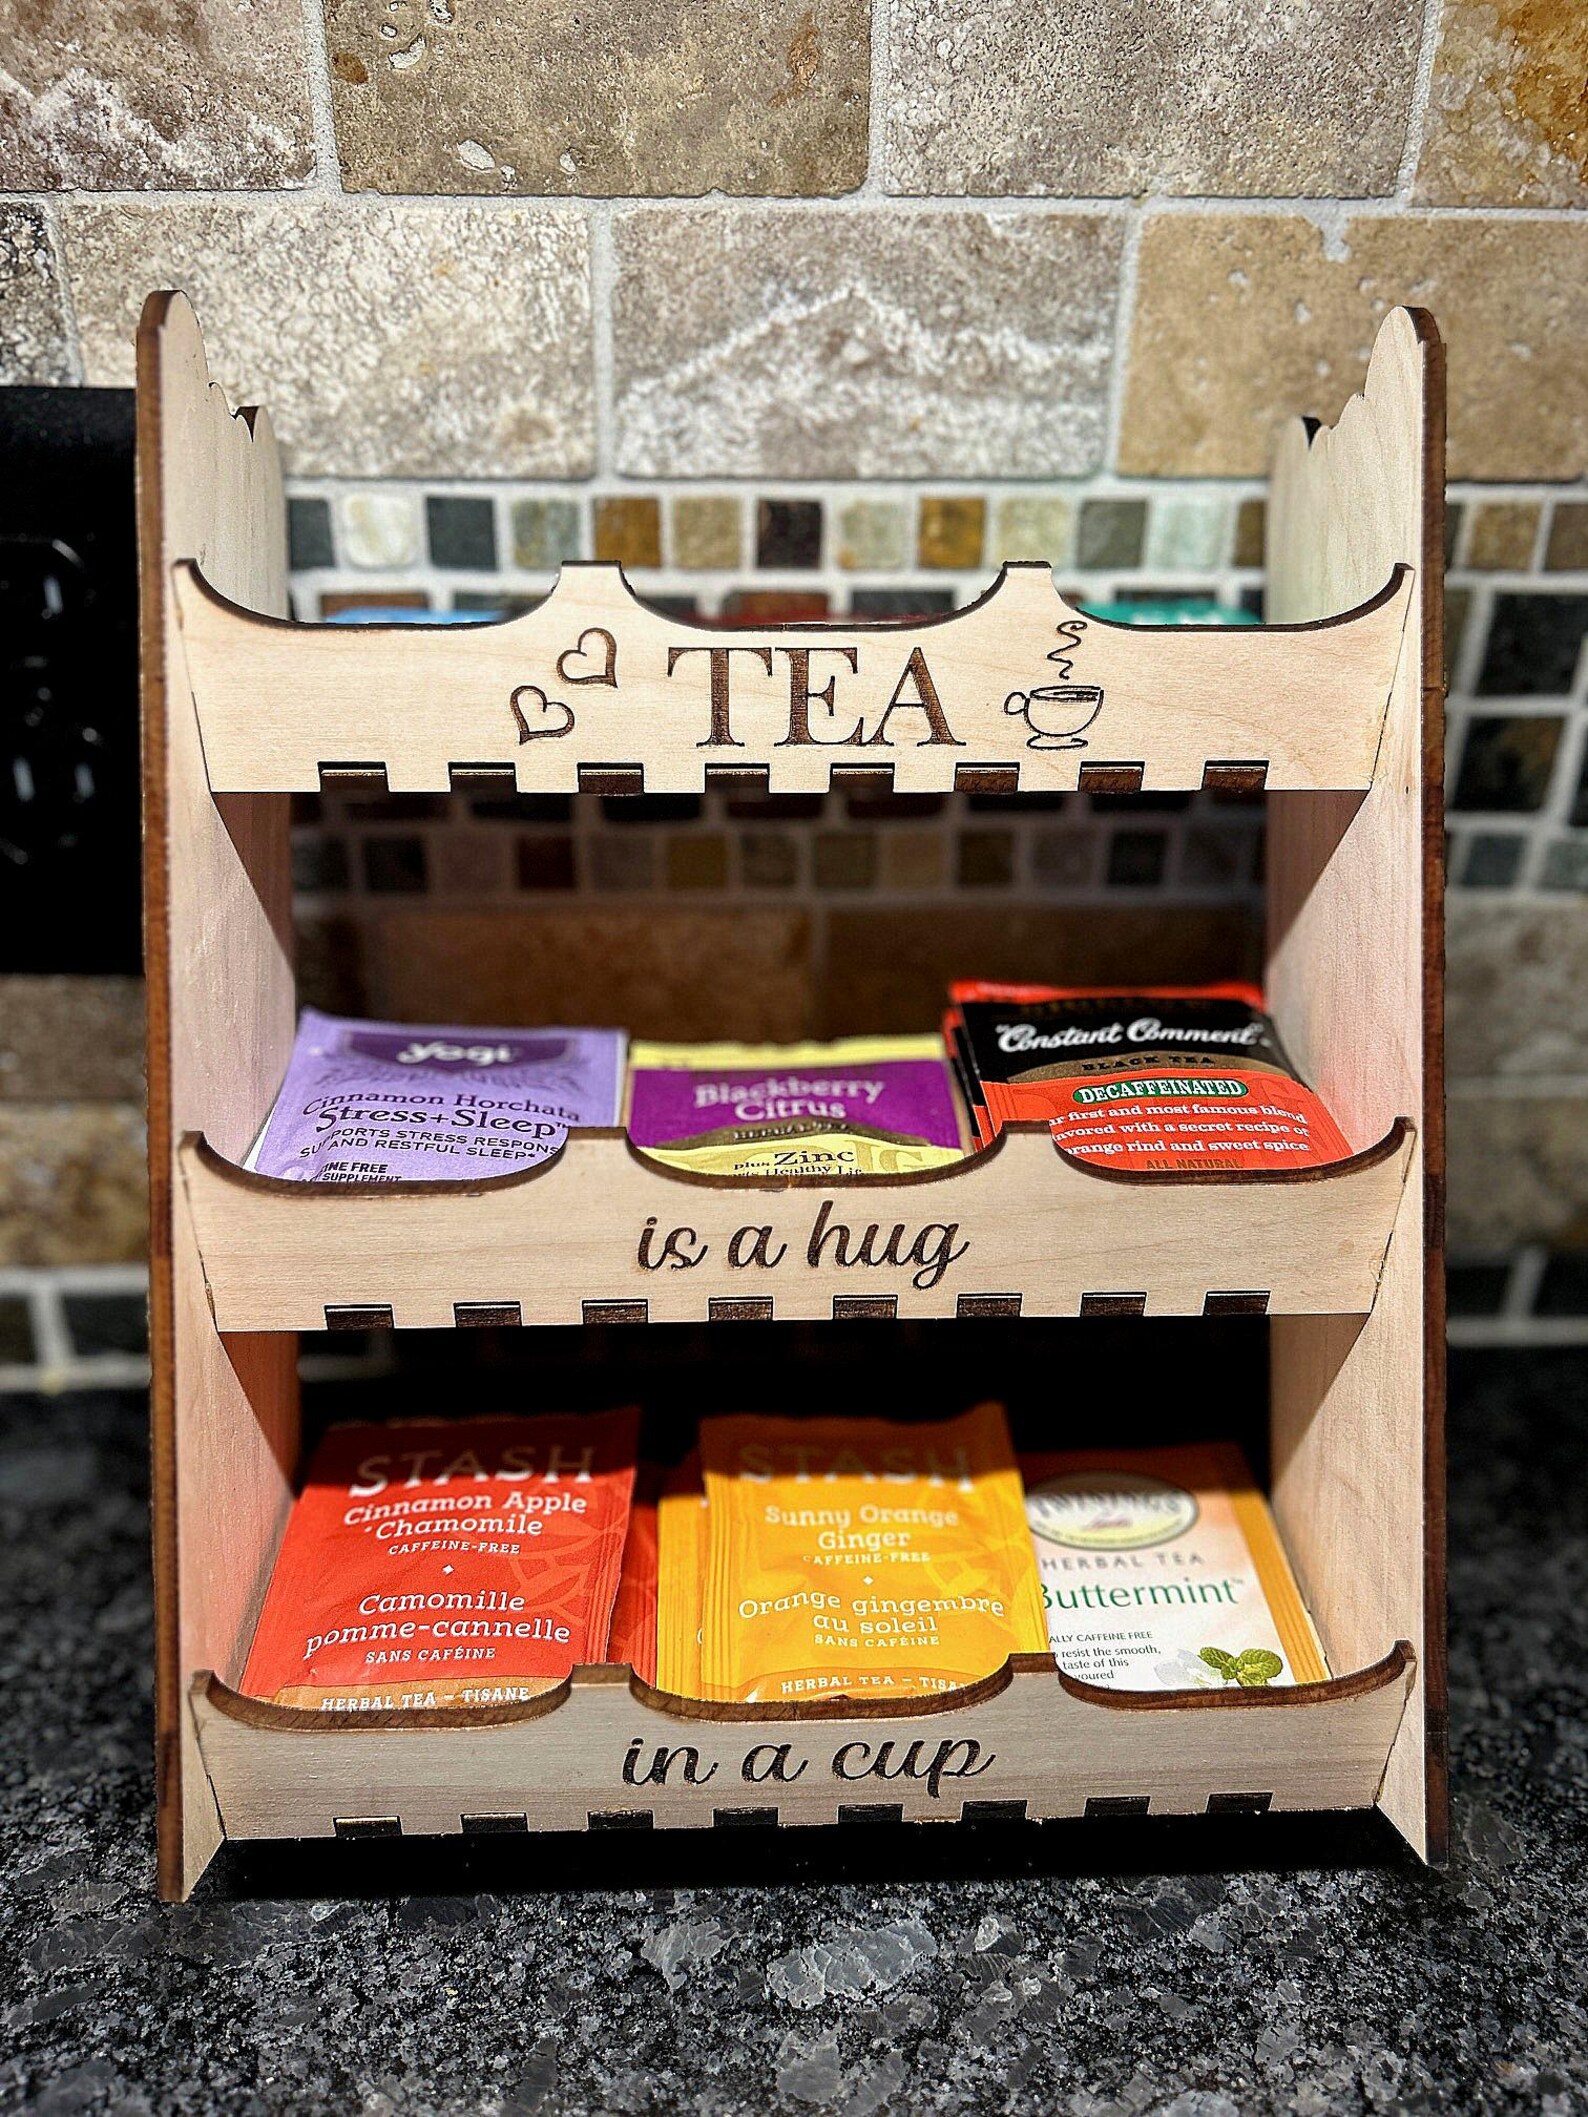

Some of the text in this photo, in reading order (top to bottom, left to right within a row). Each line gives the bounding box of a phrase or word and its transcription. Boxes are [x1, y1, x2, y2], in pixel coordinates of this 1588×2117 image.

[667, 646, 966, 747] TEA
[1082, 1055, 1216, 1071] BLACK TEA
[693, 1075, 884, 1108] Blackberry
[1080, 1078, 1242, 1103] DECAFFEINATED
[302, 1091, 580, 1121] Cinnamon Horchata
[735, 1099, 847, 1121] Citrus
[1068, 1109, 1106, 1121] first
[1108, 1105, 1142, 1116] and
[1145, 1104, 1190, 1115] most
[1192, 1103, 1258, 1115] famous
[1259, 1105, 1308, 1125] blend
[396, 1130, 467, 1143] STRESS
[1118, 1121, 1162, 1133] with
[1164, 1123, 1176, 1132] a
[1178, 1121, 1234, 1132] secret
[1235, 1121, 1291, 1134] recipe
[327, 1138, 368, 1151] AND
[374, 1139, 460, 1154] RESTFUL
[1126, 1140, 1166, 1152] rind
[1170, 1140, 1206, 1152] and
[1208, 1139, 1261, 1151] sweet
[1263, 1139, 1310, 1153] spice
[351, 1163, 388, 1173] FREE
[774, 1150, 854, 1165] Zinc
[1146, 1159, 1243, 1169] ALL NATURAL
[637, 1200, 970, 1290] is a hug
[347, 1446, 597, 1497] STASH
[343, 1491, 588, 1526] Cinnamon Apple
[764, 1503, 959, 1528] Sunny Orange
[375, 1513, 543, 1540] Chamomile
[388, 1540, 520, 1556] CAFFEINE-FREE
[817, 1529, 911, 1552] Ginger
[803, 1552, 931, 1565] CAFFEINE-FREE
[1041, 1551, 1205, 1572] HERBAL TEA
[358, 1589, 525, 1616] Camomille
[738, 1591, 1005, 1620] Orange gingembre
[813, 1615, 938, 1635] au soleil
[303, 1615, 571, 1660] pomme-cannelle
[814, 1634, 858, 1648] SANS
[1076, 1632, 1126, 1642] CAFFEINE
[1128, 1631, 1153, 1640] FREE
[365, 1646, 497, 1664] SANS CAFÉINE
[1062, 1648, 1090, 1658] resist
[1093, 1647, 1111, 1657] the
[1115, 1644, 1161, 1656] smooth,
[1063, 1658, 1129, 1670] taste of this
[781, 1676, 852, 1694] HERBAL
[859, 1675, 895, 1686] TEA
[321, 1696, 394, 1712] HERBAL
[401, 1691, 436, 1708] TEA
[461, 1687, 530, 1704] TISANE
[622, 1737, 996, 1800] in a cup
